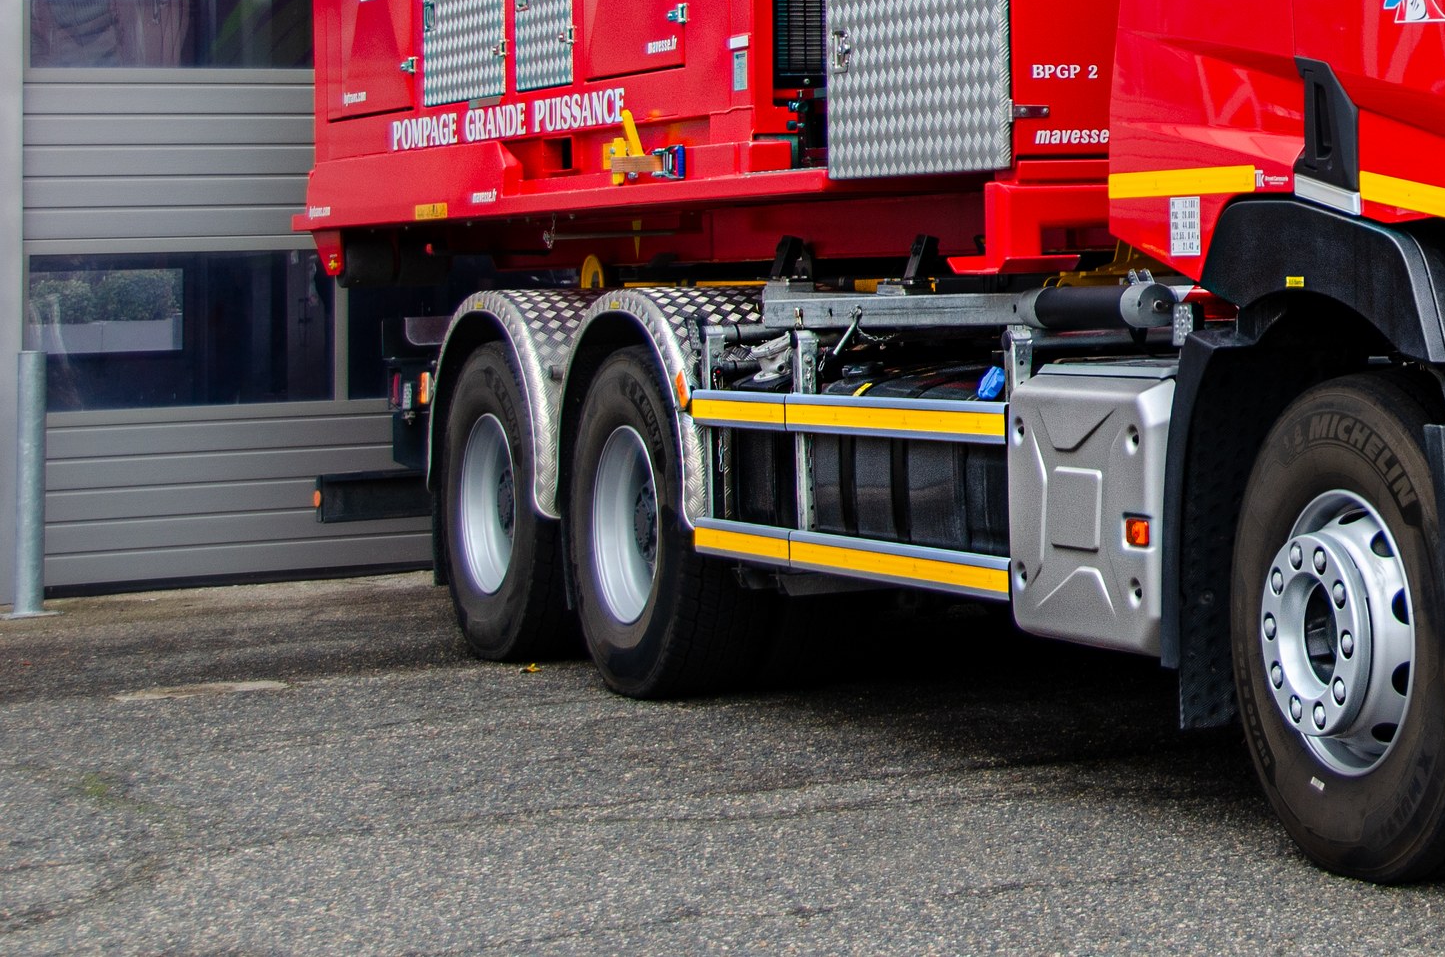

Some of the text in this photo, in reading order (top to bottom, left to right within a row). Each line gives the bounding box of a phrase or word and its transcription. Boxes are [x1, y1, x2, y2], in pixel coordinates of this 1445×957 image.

[647, 35, 677, 54] mavesse.fr
[1032, 64, 1098, 79] BPGP 2
[392, 87, 625, 151] POMPAGE GRANDE PUISSANCE
[1035, 129, 1110, 144] mavesse
[1308, 413, 1418, 508] MICHELIN
